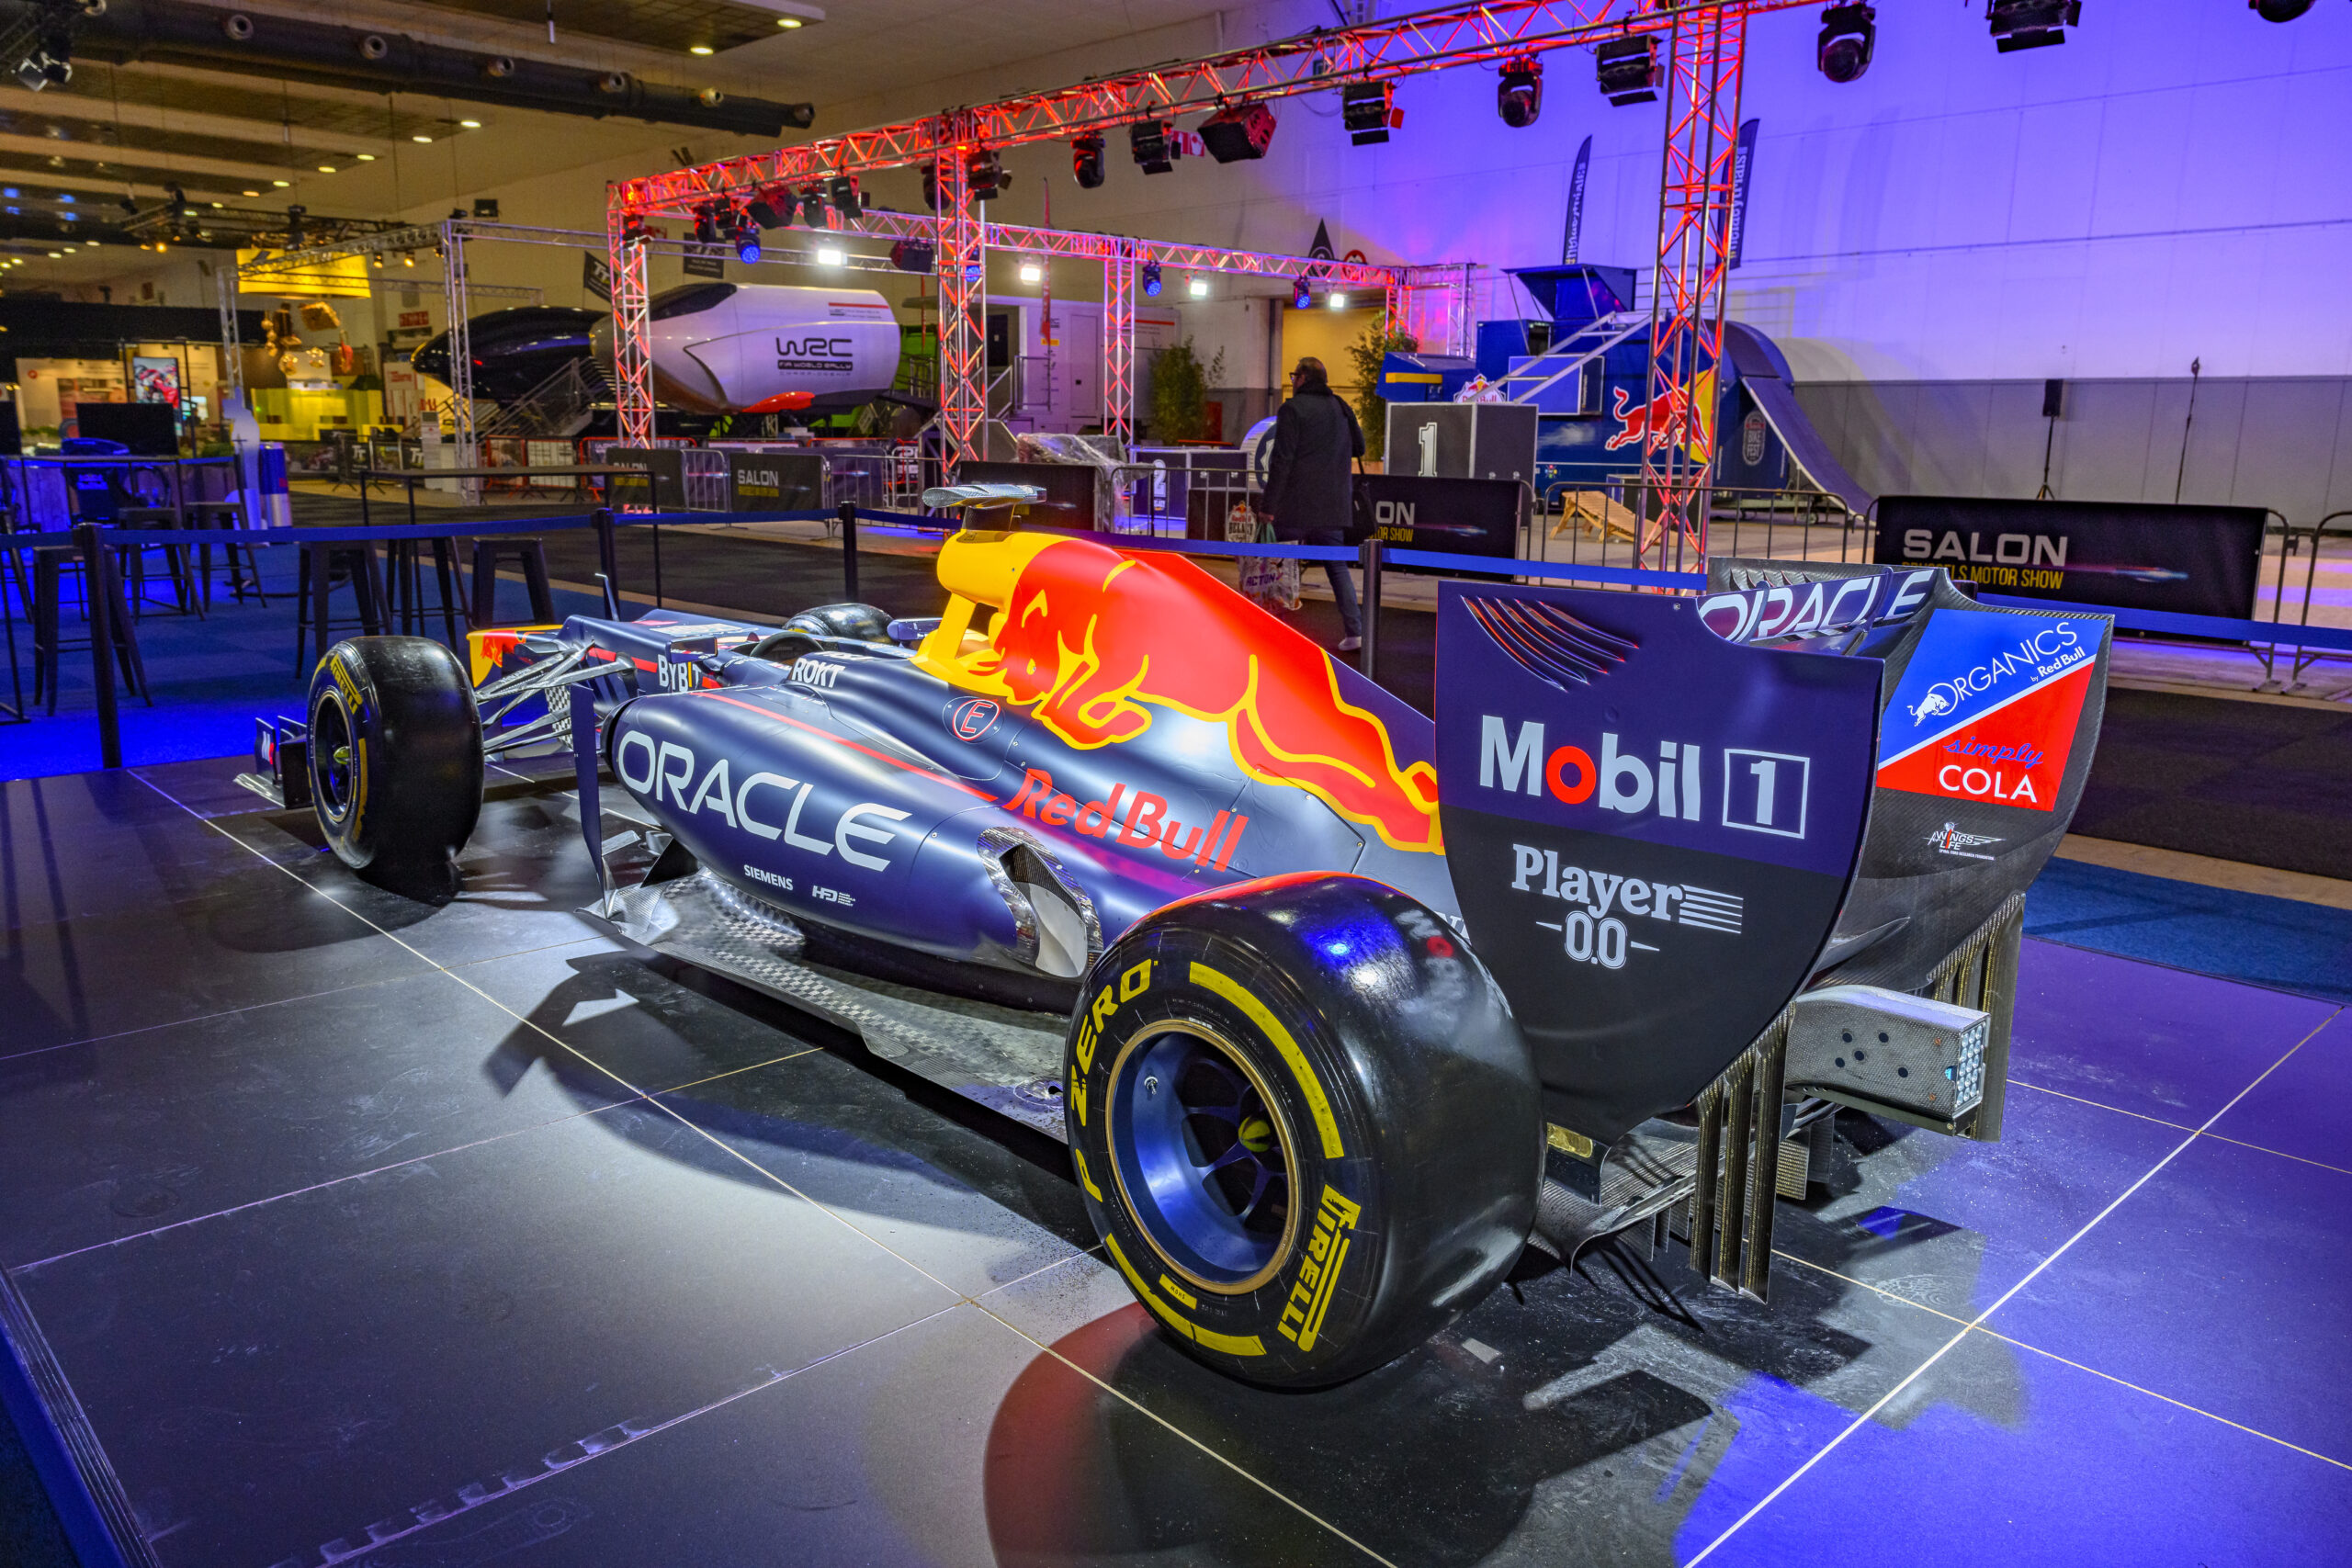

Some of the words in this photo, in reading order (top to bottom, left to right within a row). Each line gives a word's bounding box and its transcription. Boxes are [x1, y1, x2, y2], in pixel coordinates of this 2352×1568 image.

[775, 337, 853, 357] WRC
[1419, 422, 1438, 477] 1
[738, 469, 780, 486] SALON
[1153, 459, 1167, 498] 2
[1389, 527, 1414, 542] SHOW
[1904, 529, 2068, 567] SALON
[1971, 567, 2018, 587] MOTOR
[2021, 570, 2064, 590] SHOW
[1698, 570, 1934, 643] ORACLE
[658, 654, 701, 692] BYBIT
[791, 657, 845, 688] ROKT
[1927, 621, 2077, 716] ORGANICS
[2038, 659, 2063, 678] Red
[2062, 646, 2086, 666] Bull
[330, 653, 363, 716] PIRELLI
[960, 702, 993, 733] E
[1480, 715, 1701, 821] Mobil
[1749, 760, 1776, 826] 1
[1942, 736, 2044, 769] simply
[618, 730, 912, 872] ORACLE
[1939, 764, 2038, 803] COLA
[1001, 768, 1126, 840] Red
[1115, 790, 1250, 873] Bull
[1936, 830, 1974, 844] WINGS
[743, 864, 794, 891] SIEMENS
[1511, 843, 1683, 921] Player
[1565, 910, 1628, 970] 0.0
[1070, 959, 1152, 1126] ZERO
[1076, 1148, 1103, 1202] P
[1277, 1183, 1362, 1352] PIRELLI
